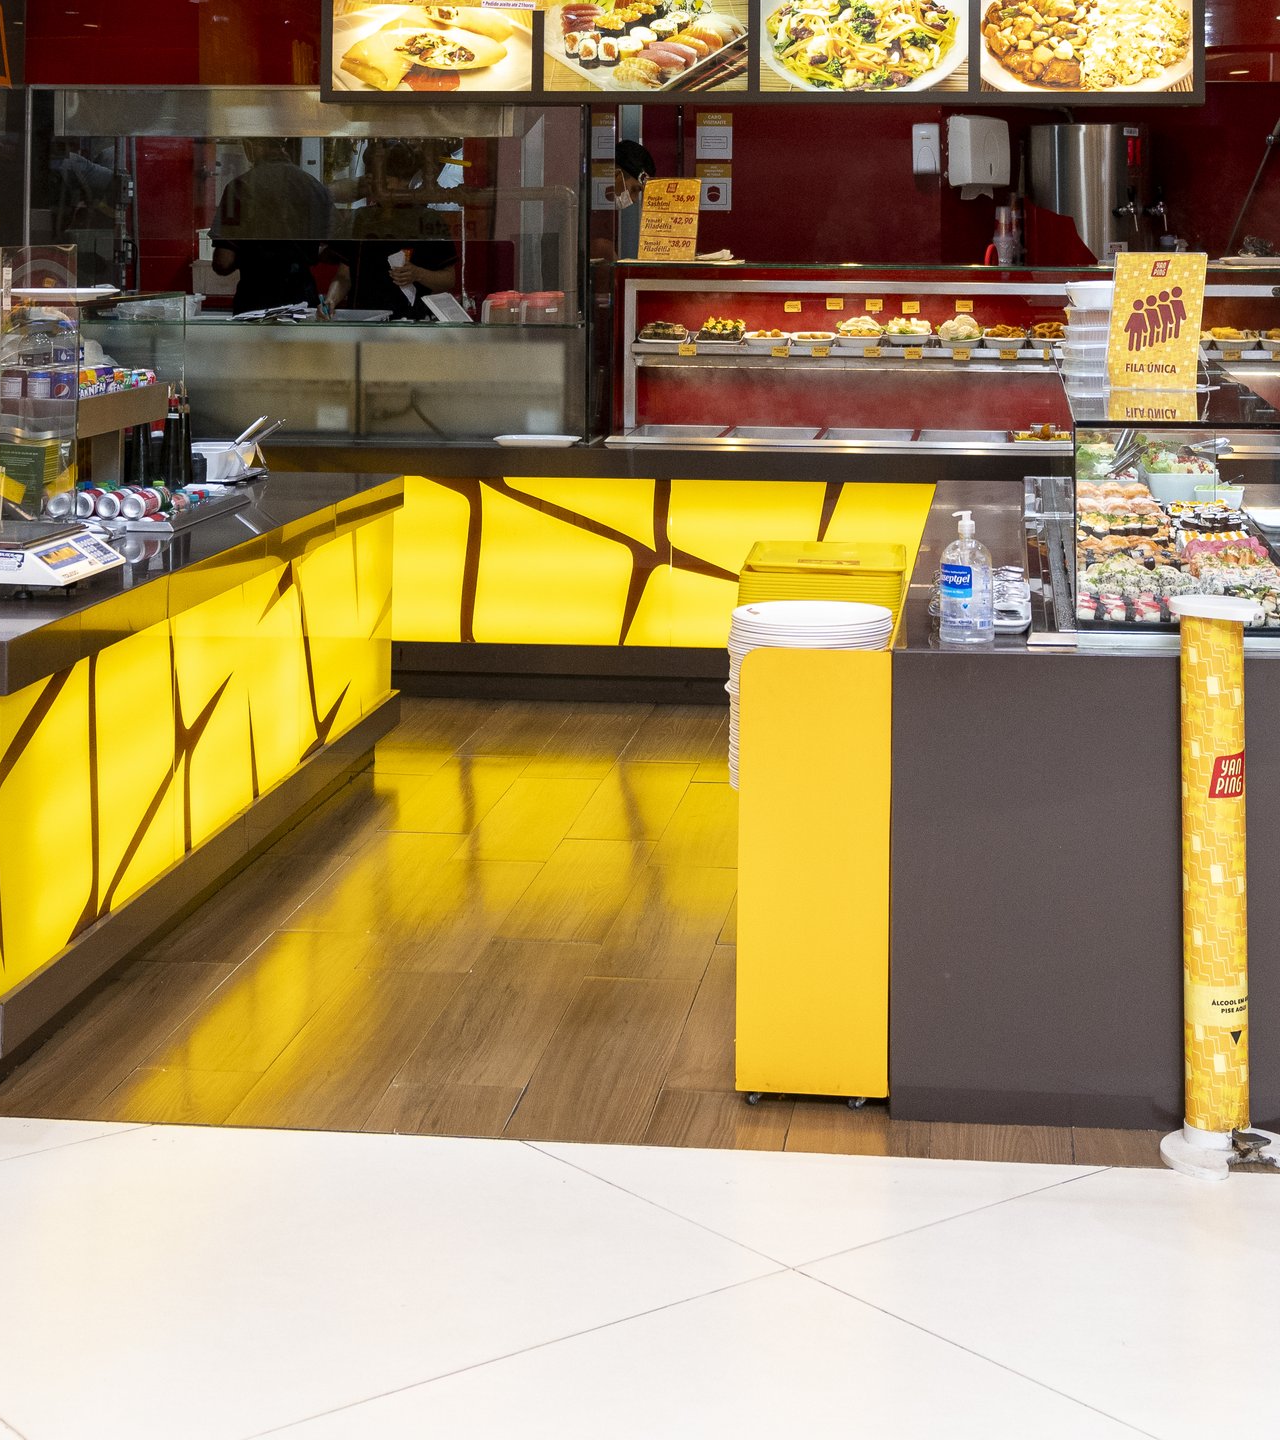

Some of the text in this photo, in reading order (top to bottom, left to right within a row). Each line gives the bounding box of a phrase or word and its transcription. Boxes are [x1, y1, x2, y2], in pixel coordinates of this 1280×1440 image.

[1125, 362, 1177, 374] FILA ÚNICA
[1220, 758, 1242, 777] YAN
[1215, 776, 1242, 795] PING
[1211, 998, 1237, 1006] ÁLCOOL
